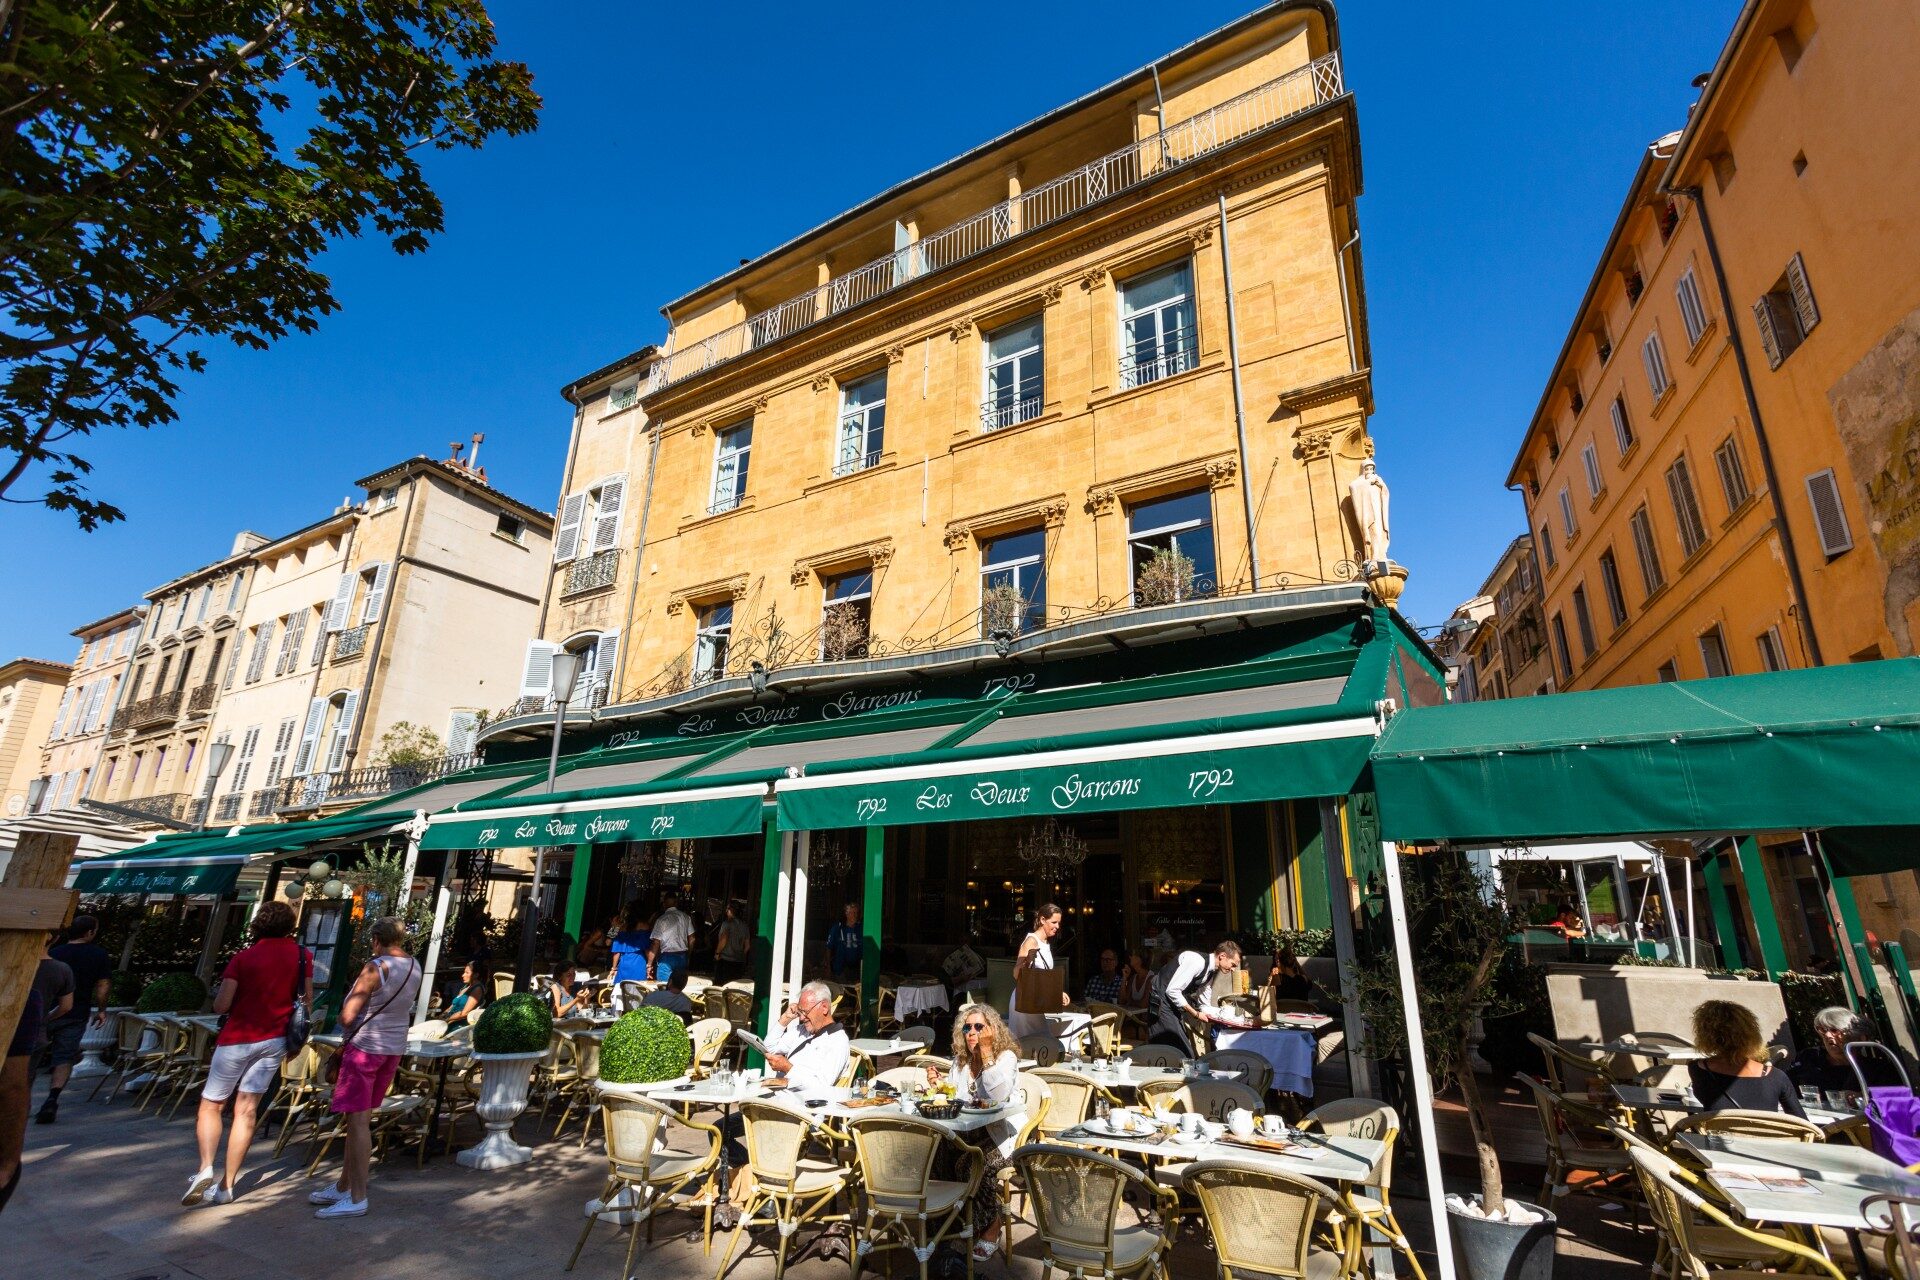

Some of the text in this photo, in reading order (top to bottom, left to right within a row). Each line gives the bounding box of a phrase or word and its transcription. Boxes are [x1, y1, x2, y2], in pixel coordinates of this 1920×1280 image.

[608, 673, 1036, 750] 1792 Les Deux Garçons 1792
[856, 768, 1235, 821] 1792 Les Deux Garçons 1792
[478, 815, 675, 845] 1792 Les Deux Garçons 1792
